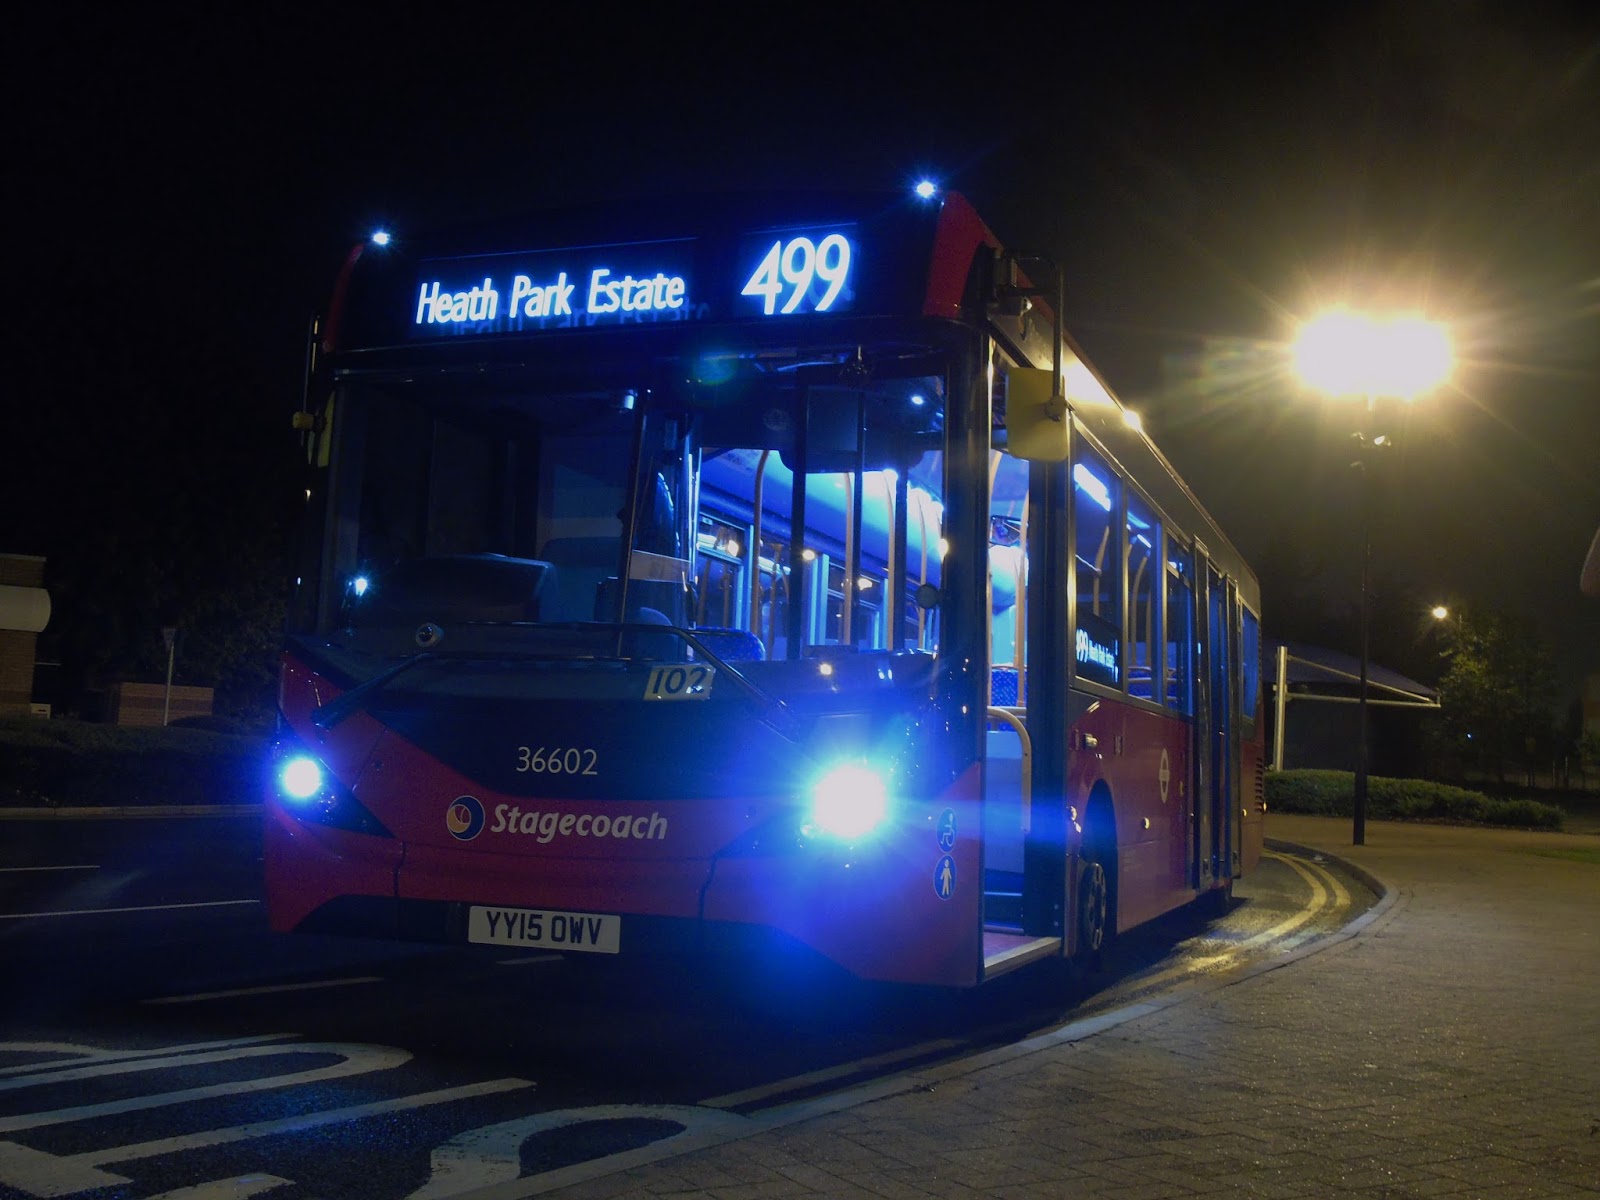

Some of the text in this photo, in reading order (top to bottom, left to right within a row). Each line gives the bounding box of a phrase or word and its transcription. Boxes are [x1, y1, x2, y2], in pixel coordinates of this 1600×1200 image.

[416, 234, 851, 324] Heath Park Estate 499
[652, 666, 707, 695] 102
[516, 746, 598, 775] 36602
[490, 803, 668, 844] Stagecoach
[486, 910, 603, 945] YY15 OWV
